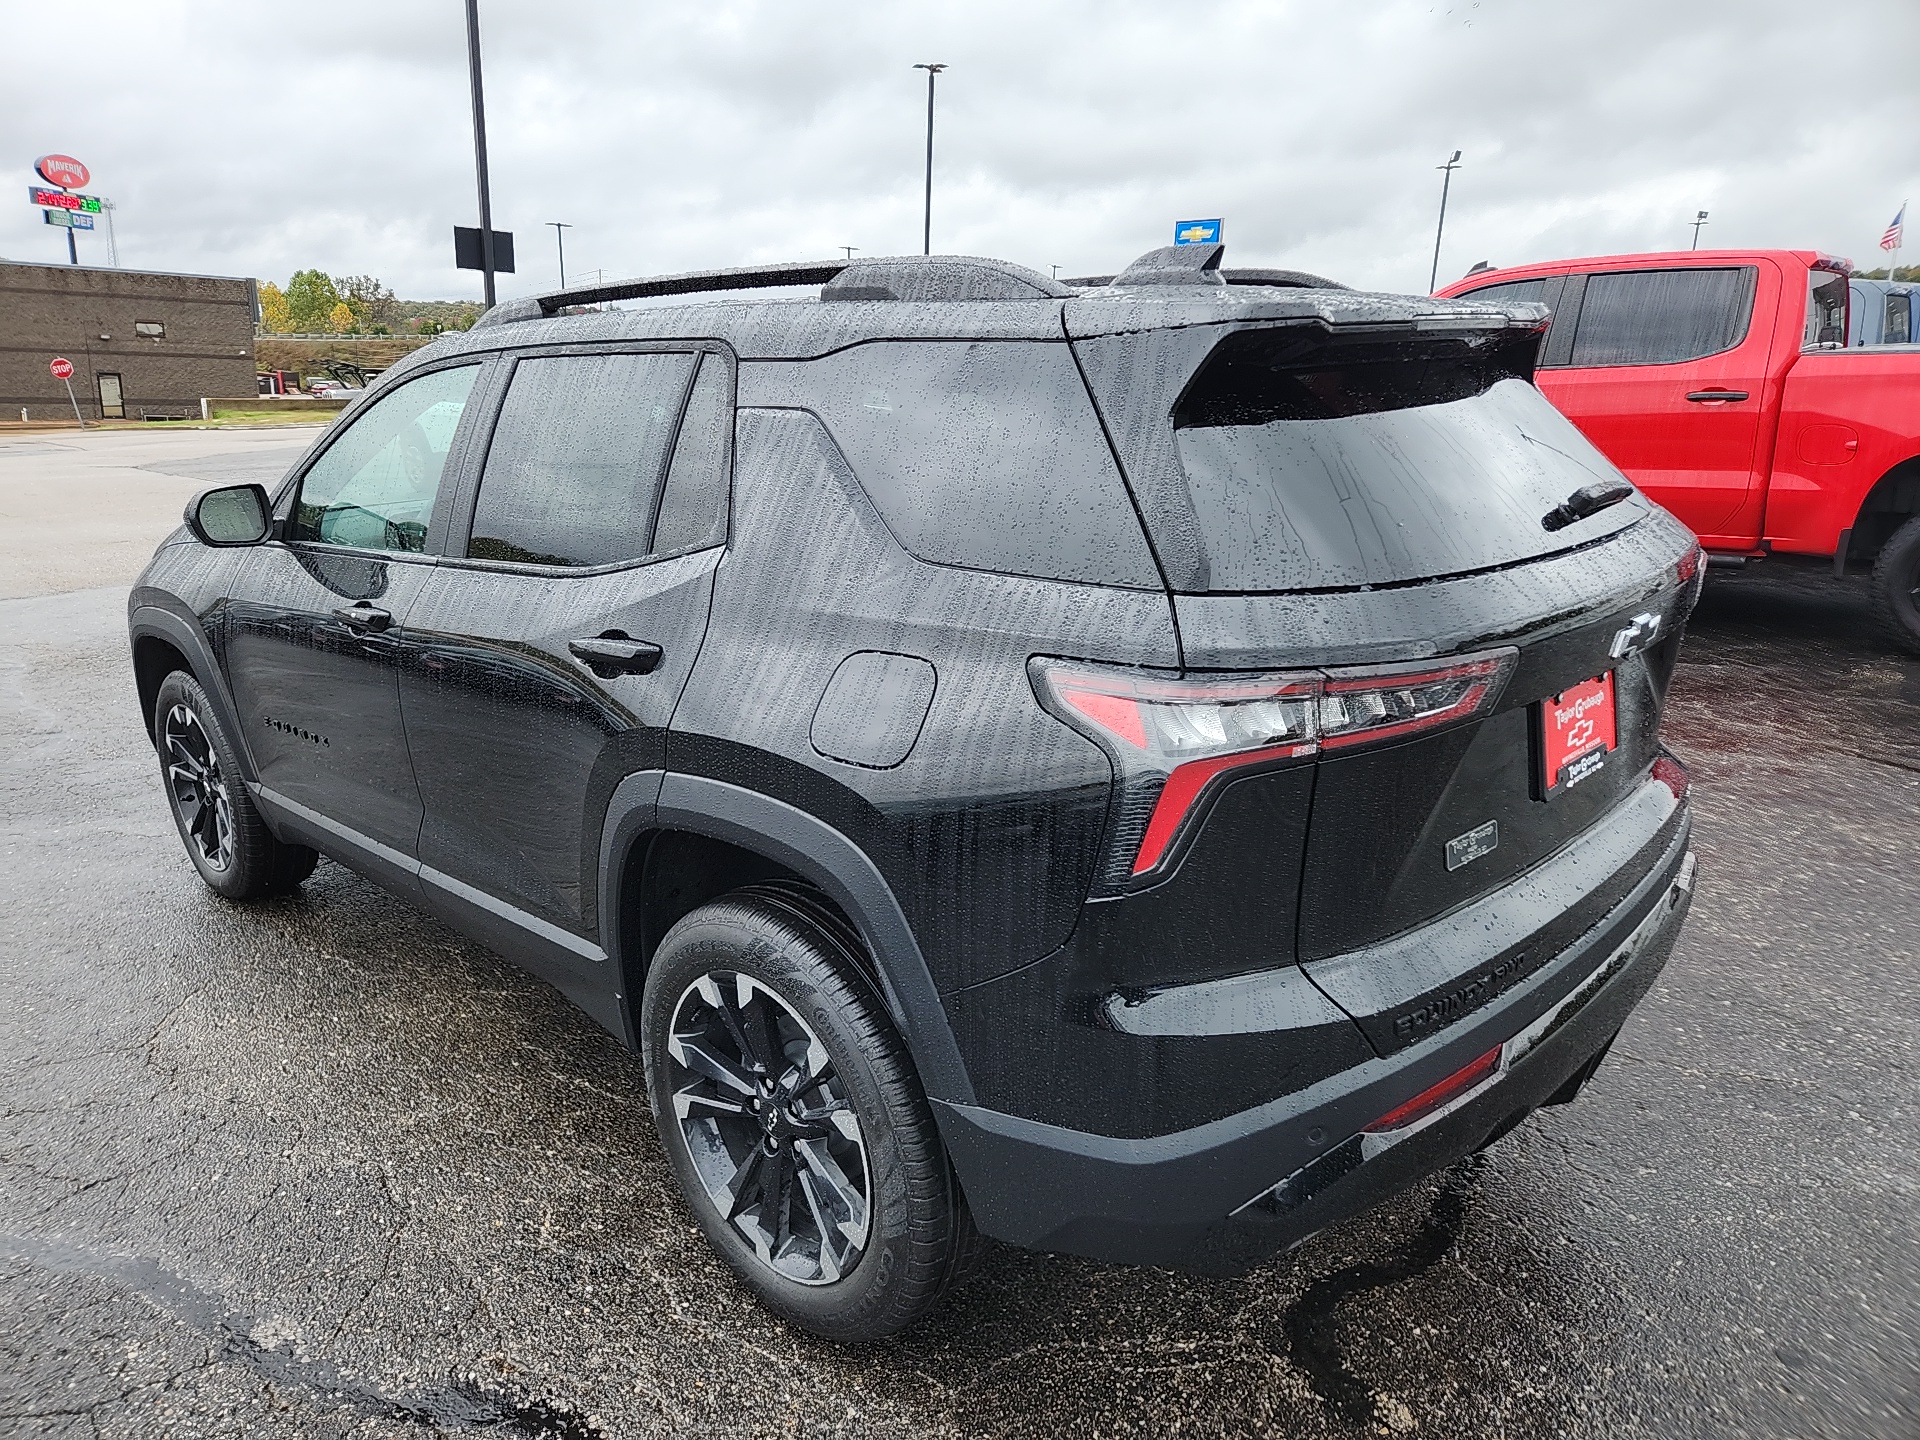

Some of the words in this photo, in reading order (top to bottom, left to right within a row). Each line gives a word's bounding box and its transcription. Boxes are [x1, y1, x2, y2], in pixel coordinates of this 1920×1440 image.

[48, 160, 83, 181] MAVERIK
[73, 215, 93, 227] DEF
[52, 364, 70, 374] STOP
